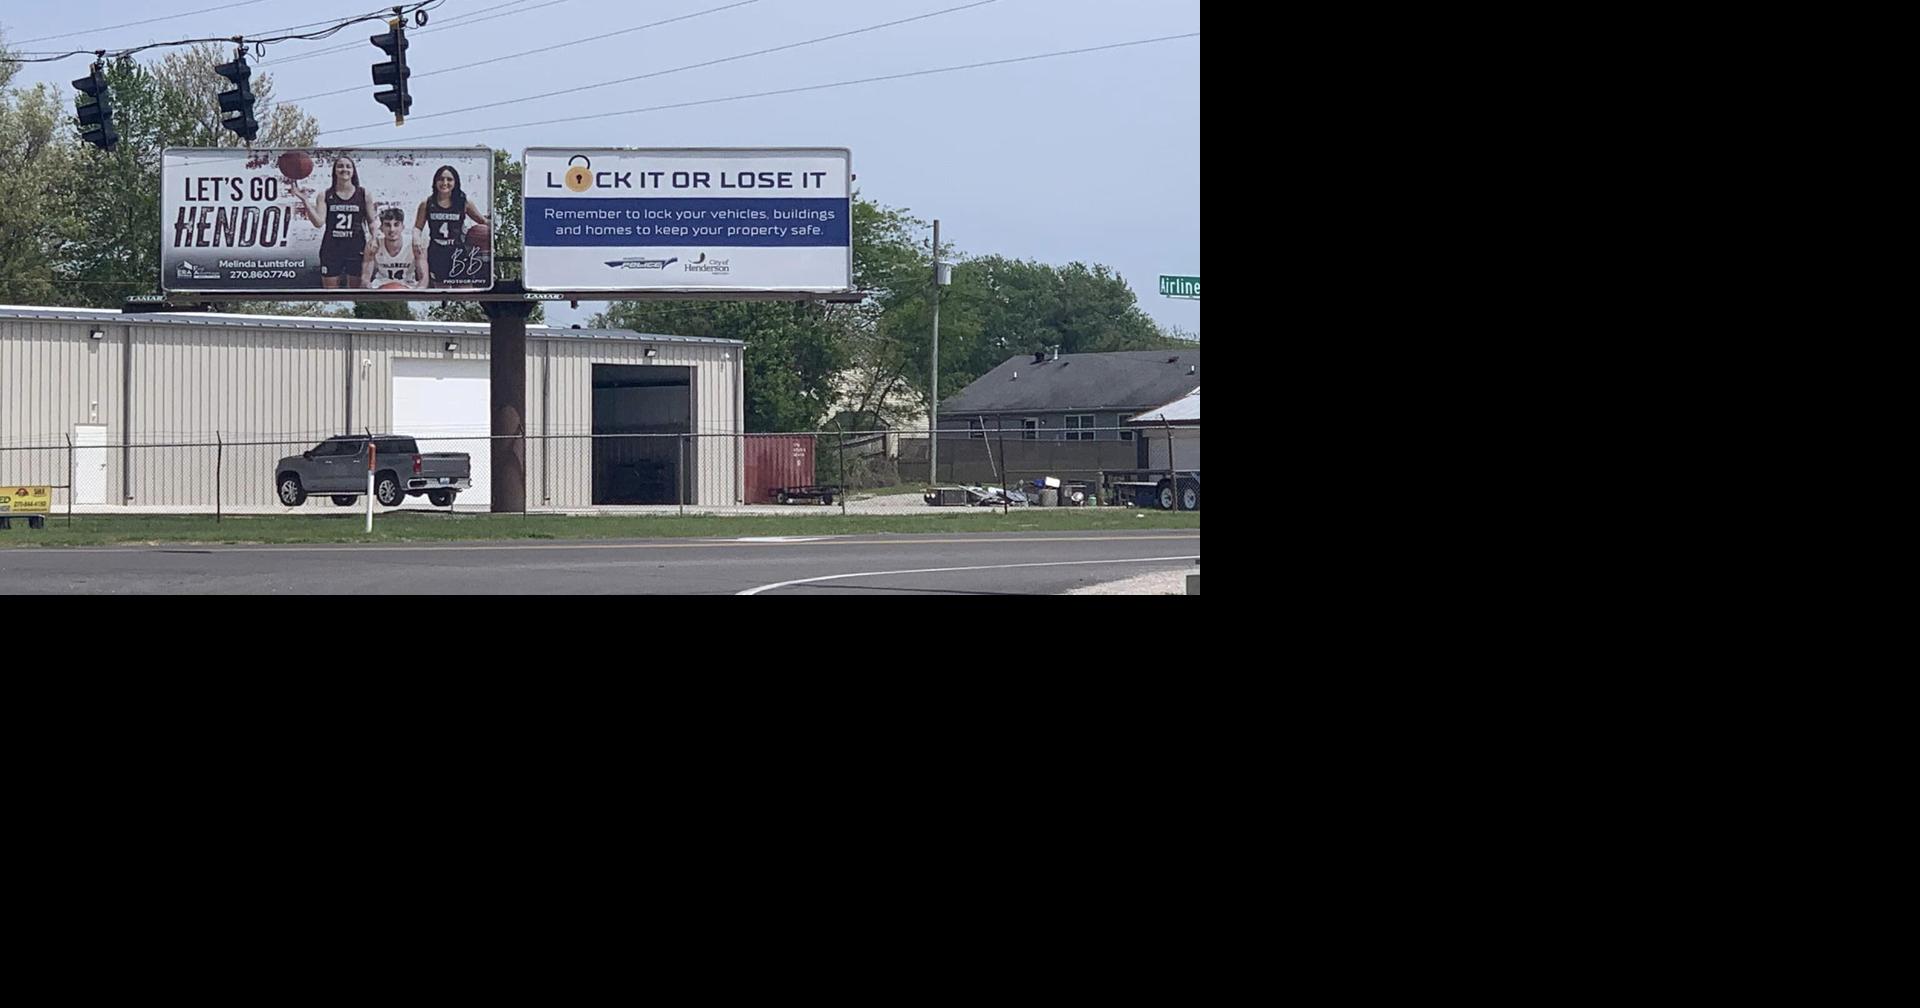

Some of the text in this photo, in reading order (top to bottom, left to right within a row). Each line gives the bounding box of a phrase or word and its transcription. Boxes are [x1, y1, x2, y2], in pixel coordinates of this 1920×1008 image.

[640, 172, 665, 188] IT
[672, 172, 711, 188] OR
[721, 172, 793, 188] LOSE
[803, 172, 827, 188] IT
[185, 177, 278, 201] LET'S GO
[336, 213, 353, 229] 21
[544, 208, 622, 219] Remember
[626, 209, 640, 219] to
[644, 208, 672, 219] lock
[676, 211, 706, 222] your
[773, 208, 835, 222] buildings
[174, 206, 291, 248] HENDO!
[439, 222, 449, 238] 4
[555, 225, 824, 237] and homes to keep your property safe.
[219, 260, 305, 268] Melinda Luntsford
[622, 261, 662, 269] POLICE
[684, 264, 730, 272] Henderson
[229, 270, 296, 279] 270.860.7740
[1161, 277, 1200, 294] Airline
